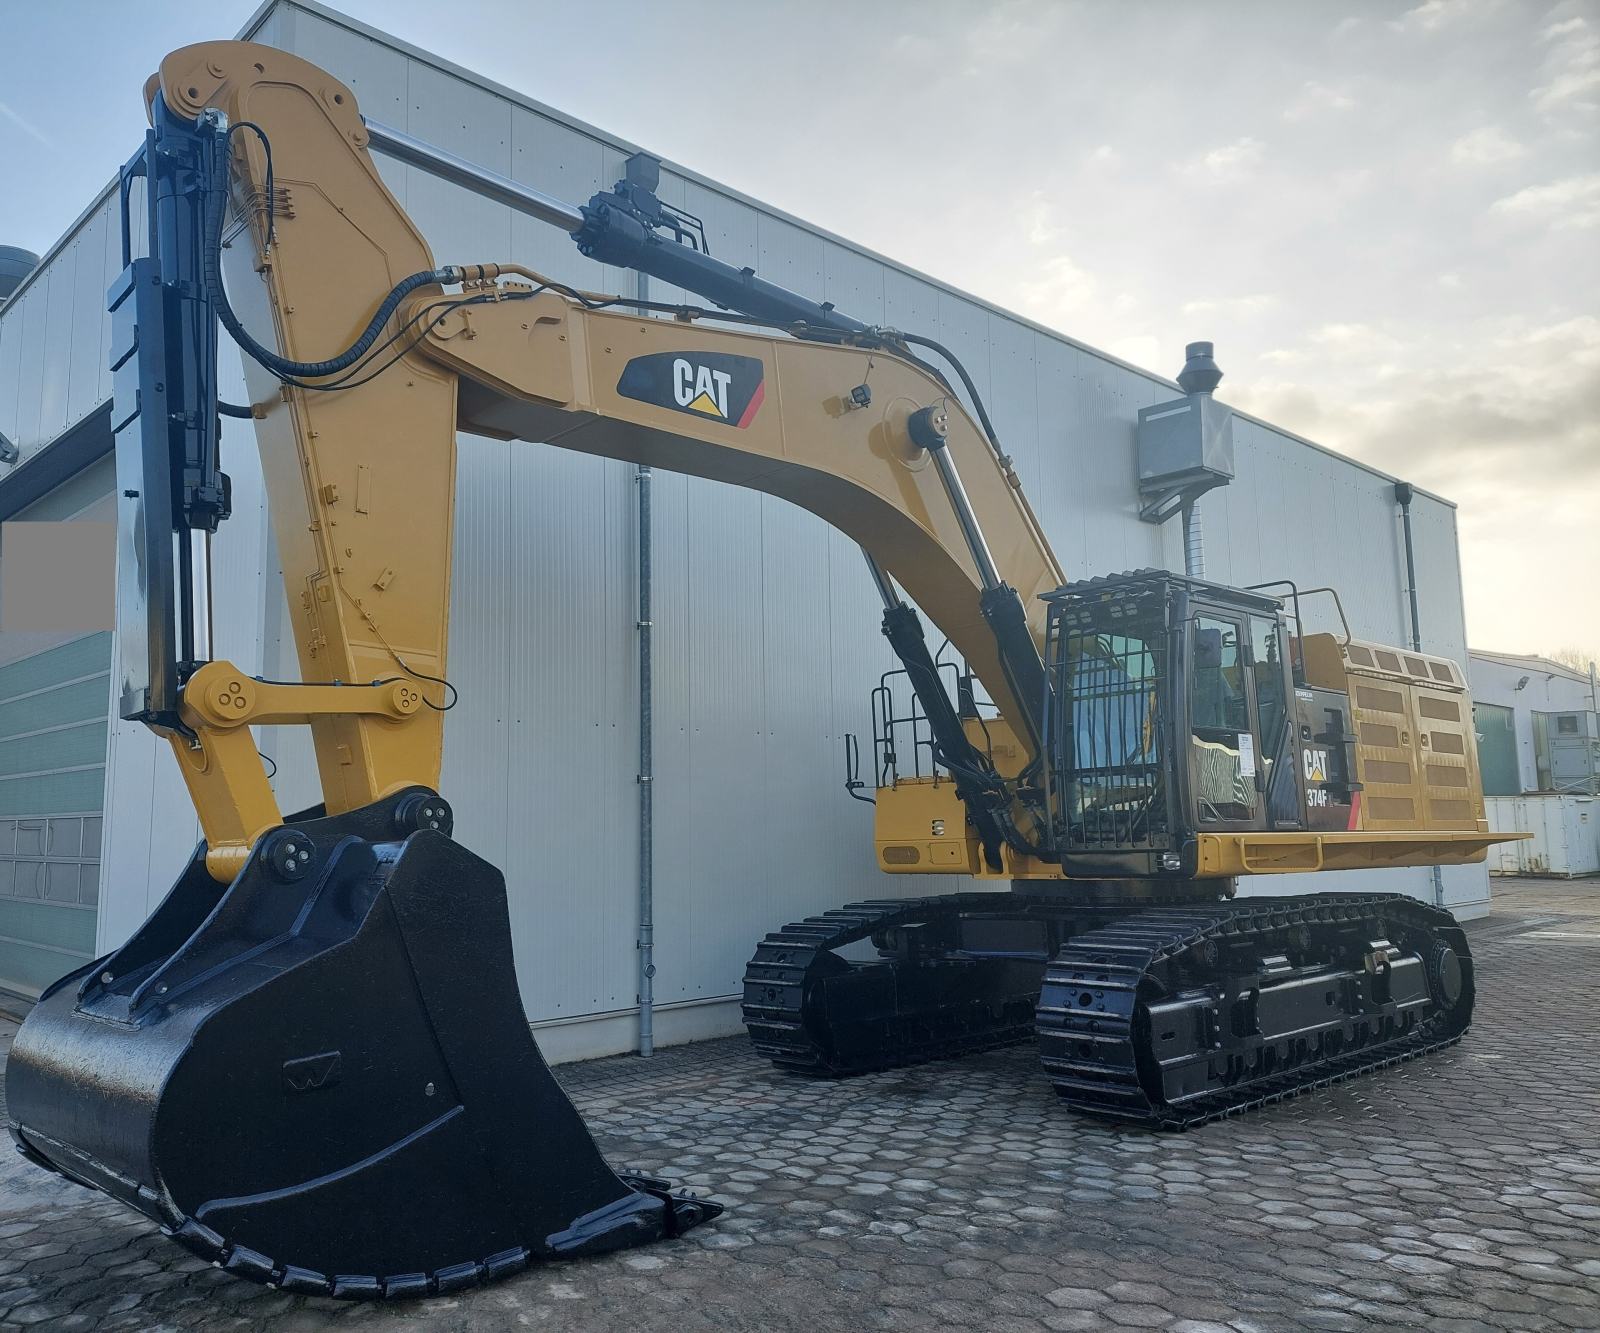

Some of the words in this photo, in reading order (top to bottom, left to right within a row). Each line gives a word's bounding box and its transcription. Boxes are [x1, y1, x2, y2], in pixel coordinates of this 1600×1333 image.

[673, 358, 732, 419] CAT
[1303, 749, 1327, 782] CAT
[1307, 789, 1328, 807] 374F
